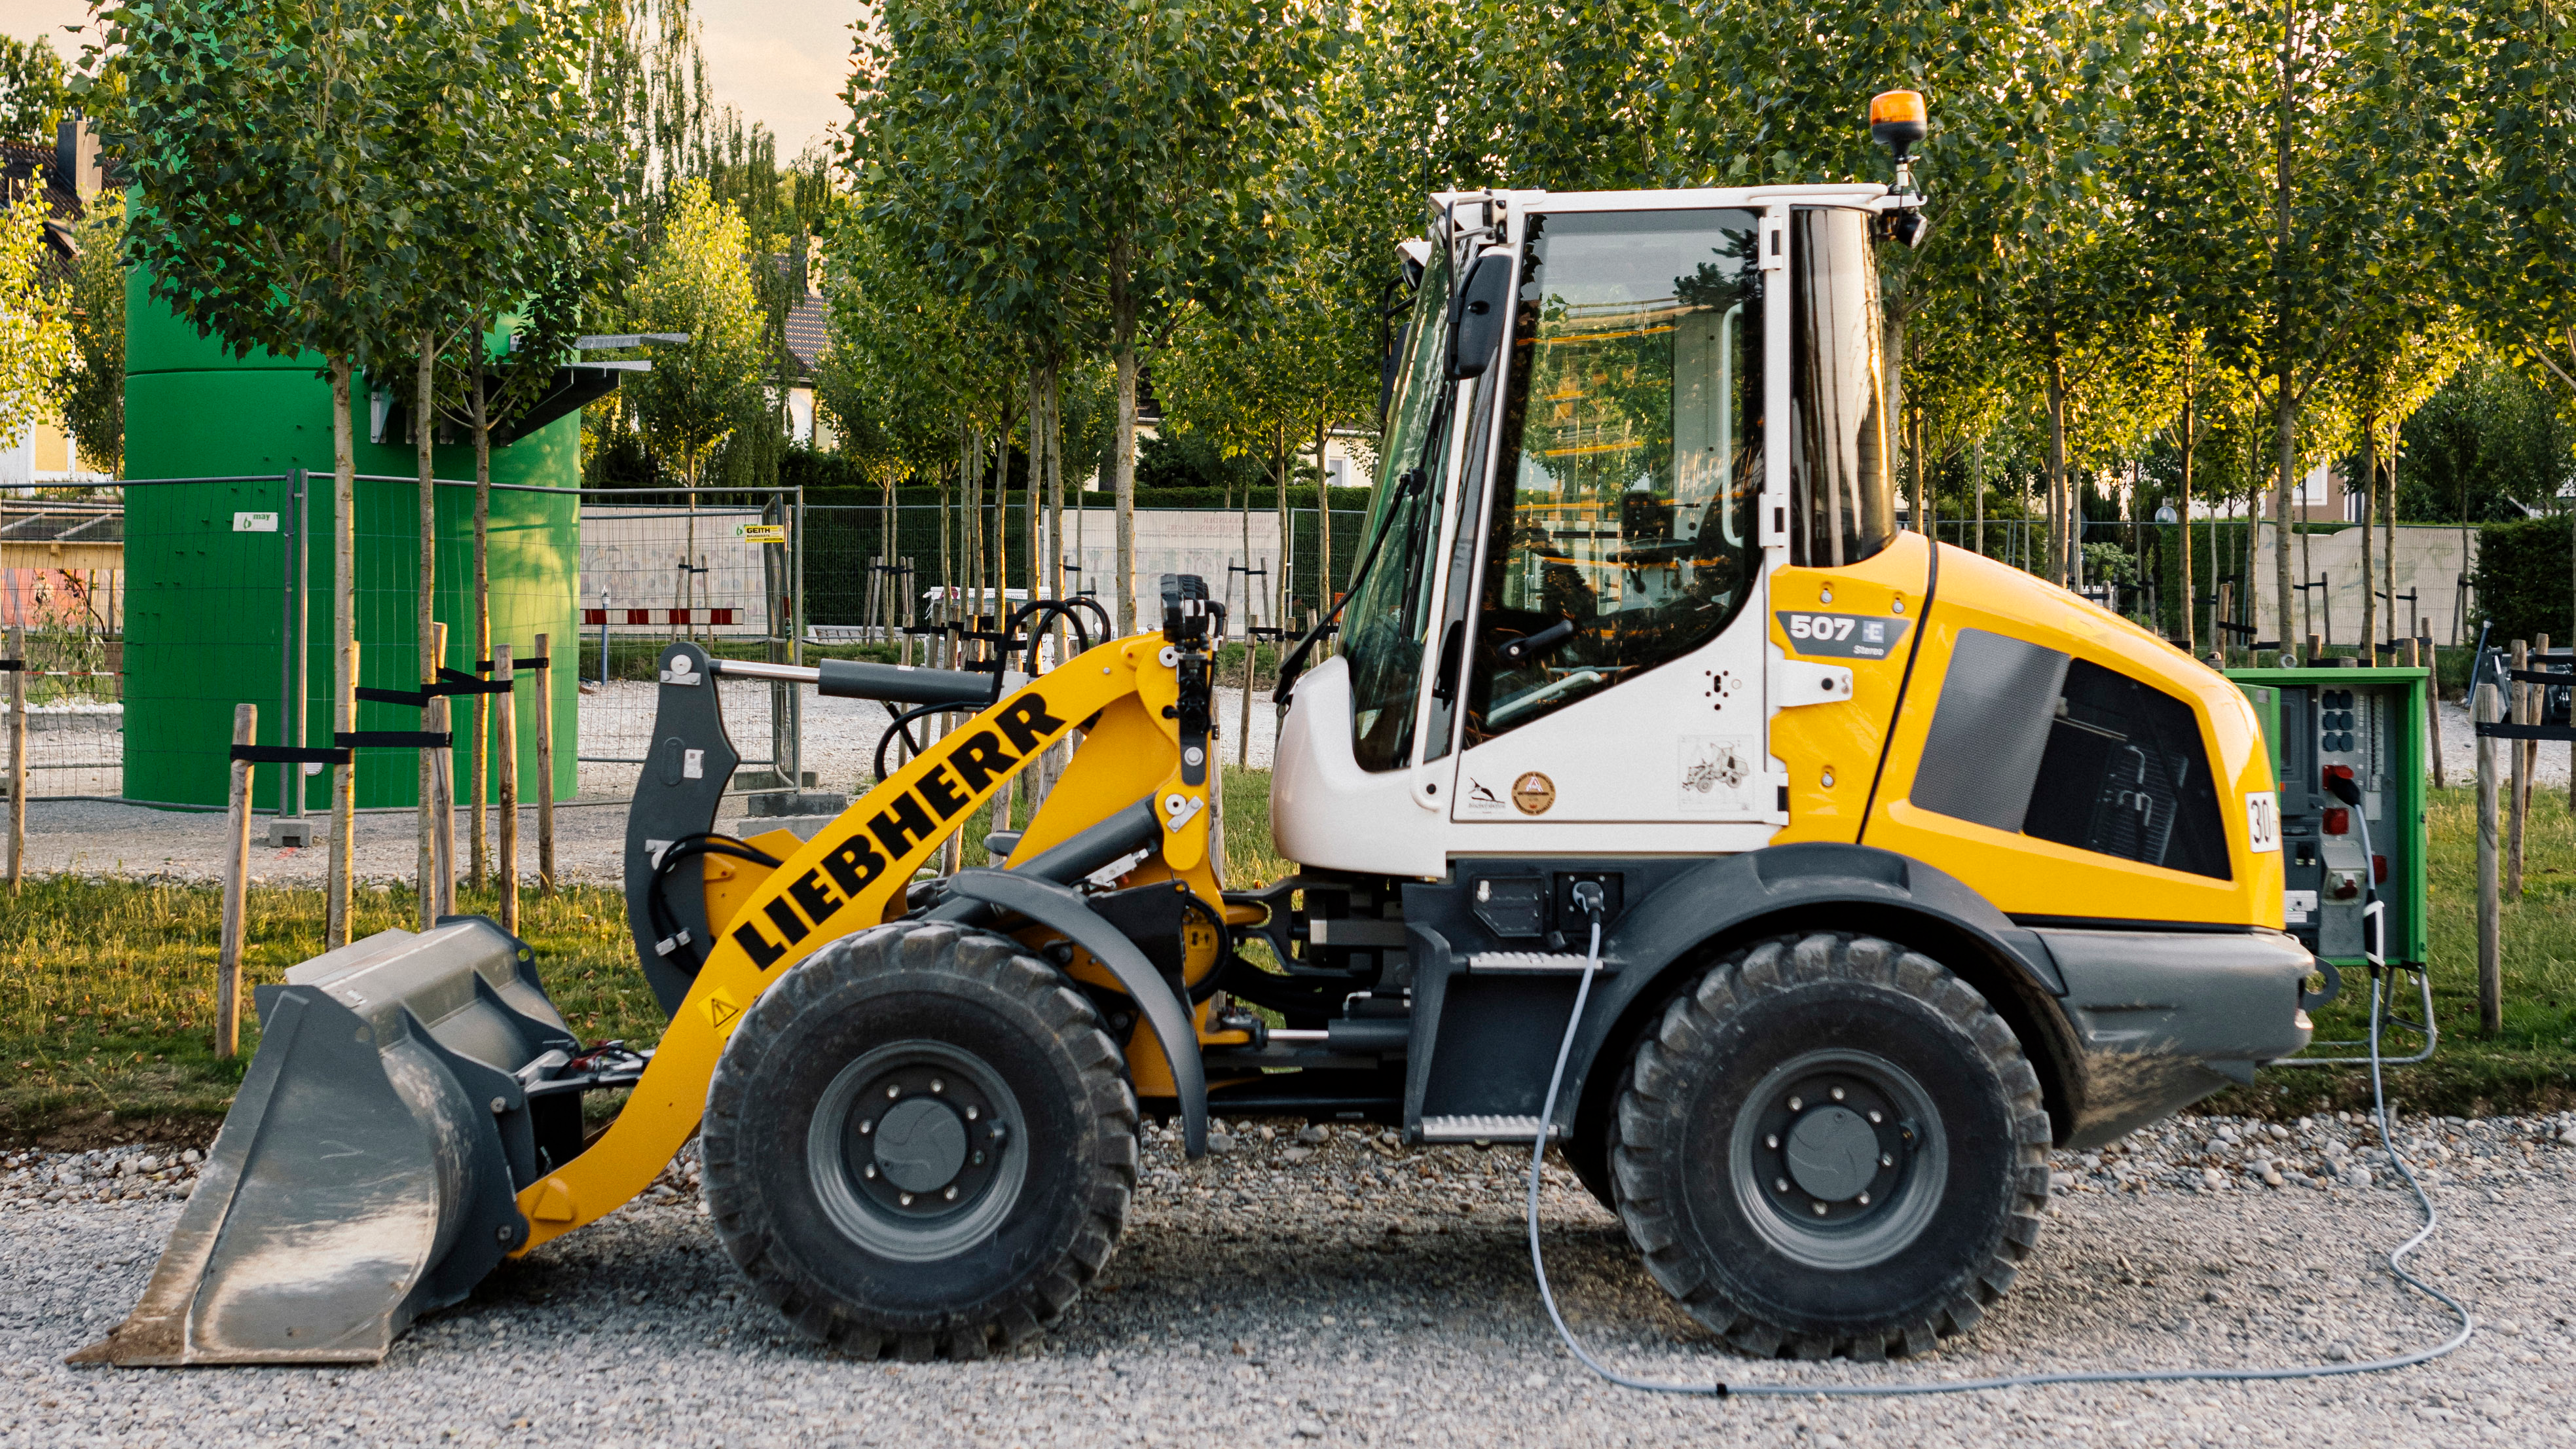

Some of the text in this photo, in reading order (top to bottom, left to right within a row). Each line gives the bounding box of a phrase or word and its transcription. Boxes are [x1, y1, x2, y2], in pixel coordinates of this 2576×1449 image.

[1790, 615, 1855, 640] 507
[1853, 644, 1885, 655] Stereo
[732, 692, 1067, 972] LIEBHERR
[2251, 799, 2272, 844] 30
